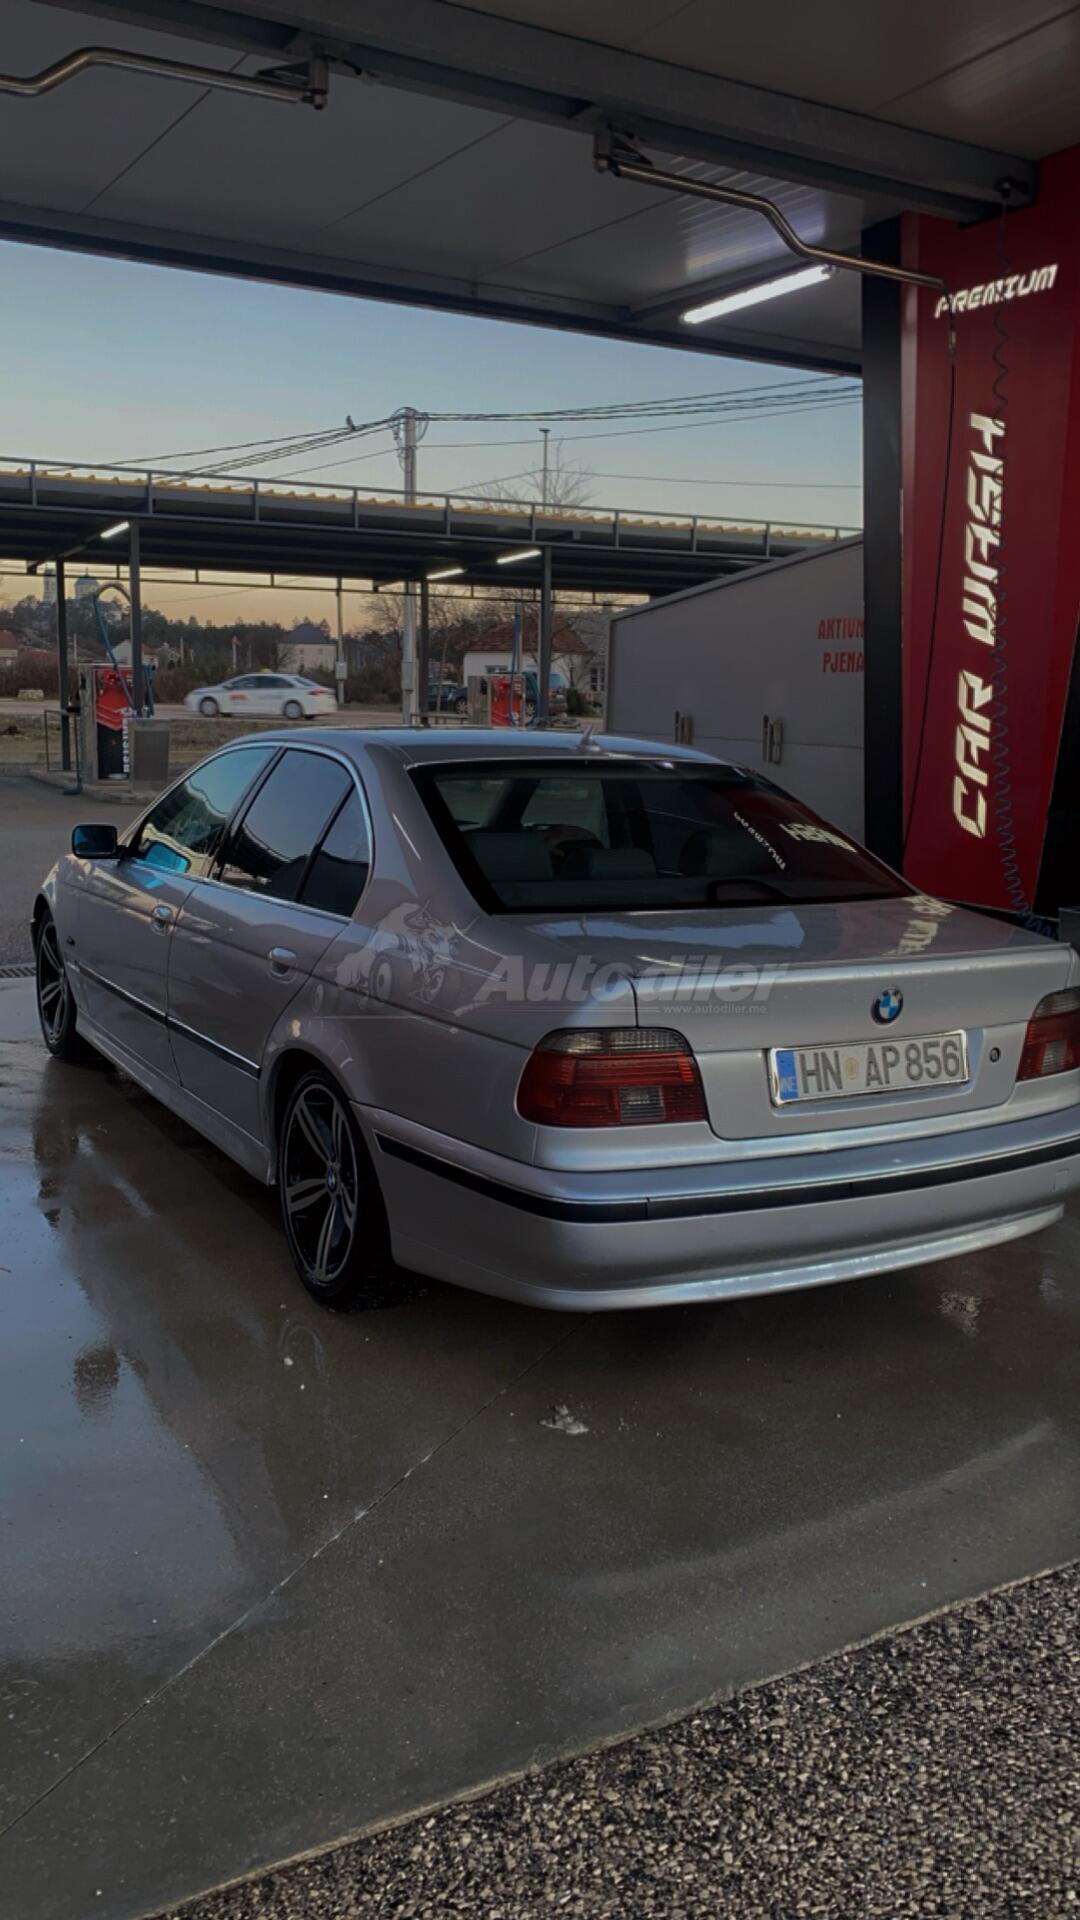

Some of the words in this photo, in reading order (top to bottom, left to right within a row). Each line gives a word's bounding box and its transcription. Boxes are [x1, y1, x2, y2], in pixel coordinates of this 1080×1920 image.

[934, 263, 1058, 319] PREMIUM
[962, 412, 1006, 647] WASH
[822, 651, 865, 673] PJENA
[953, 669, 993, 839] CAR
[800, 1051, 844, 1094] HN
